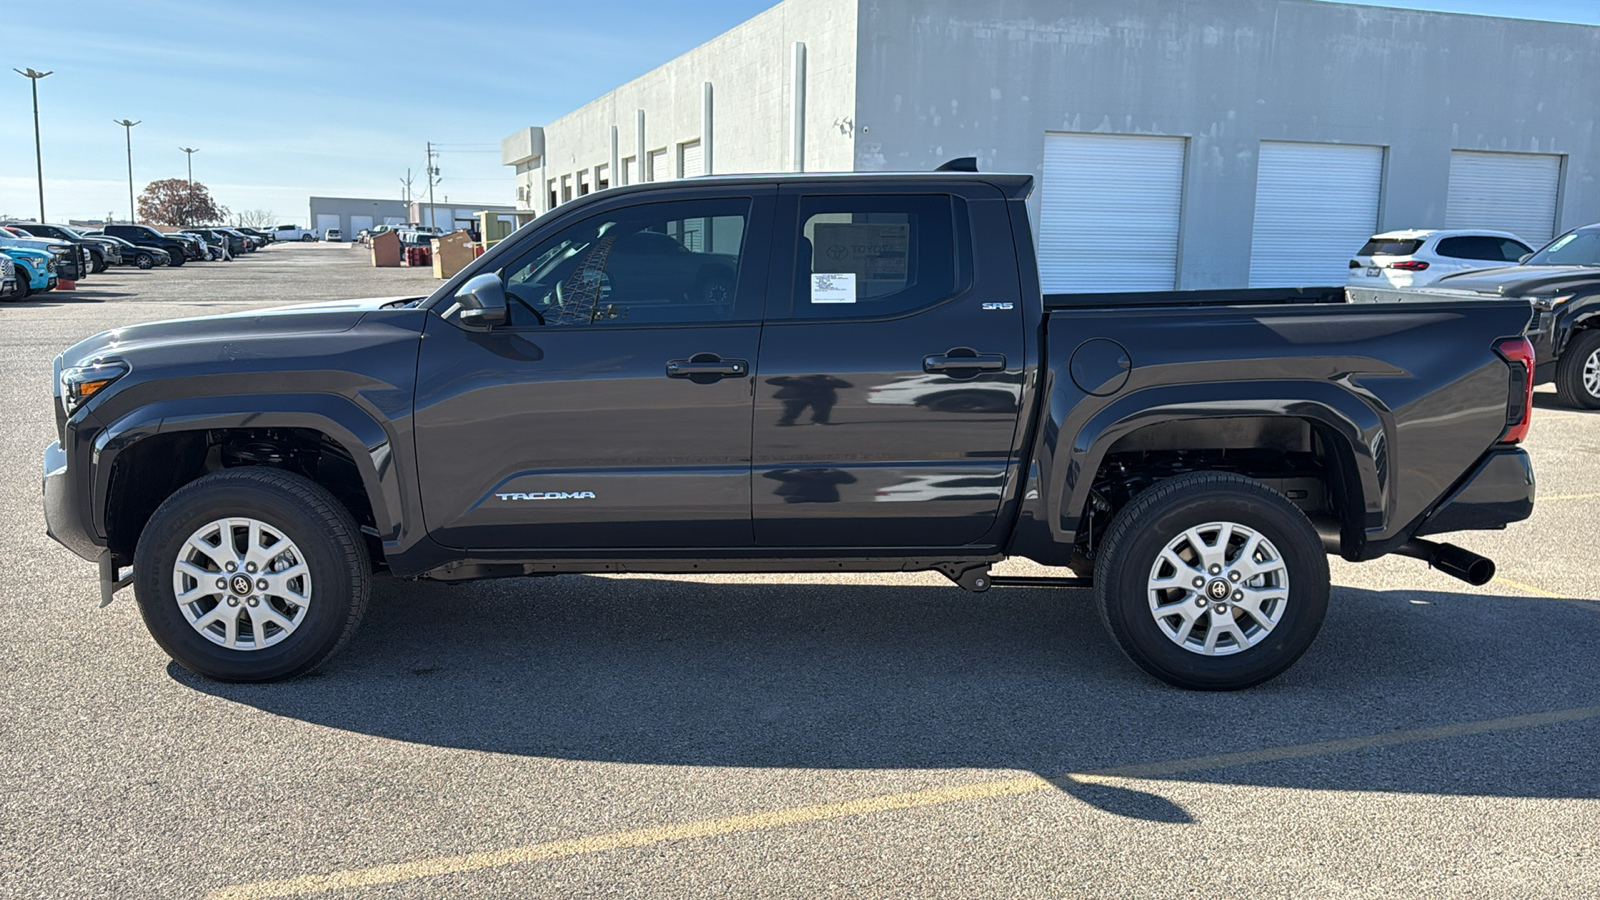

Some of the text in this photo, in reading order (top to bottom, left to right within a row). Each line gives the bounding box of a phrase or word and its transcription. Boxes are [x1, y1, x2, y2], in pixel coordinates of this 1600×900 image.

[851, 244, 893, 254] TOYOT
[982, 302, 1014, 310] SR5
[495, 491, 596, 501] TACOMA
